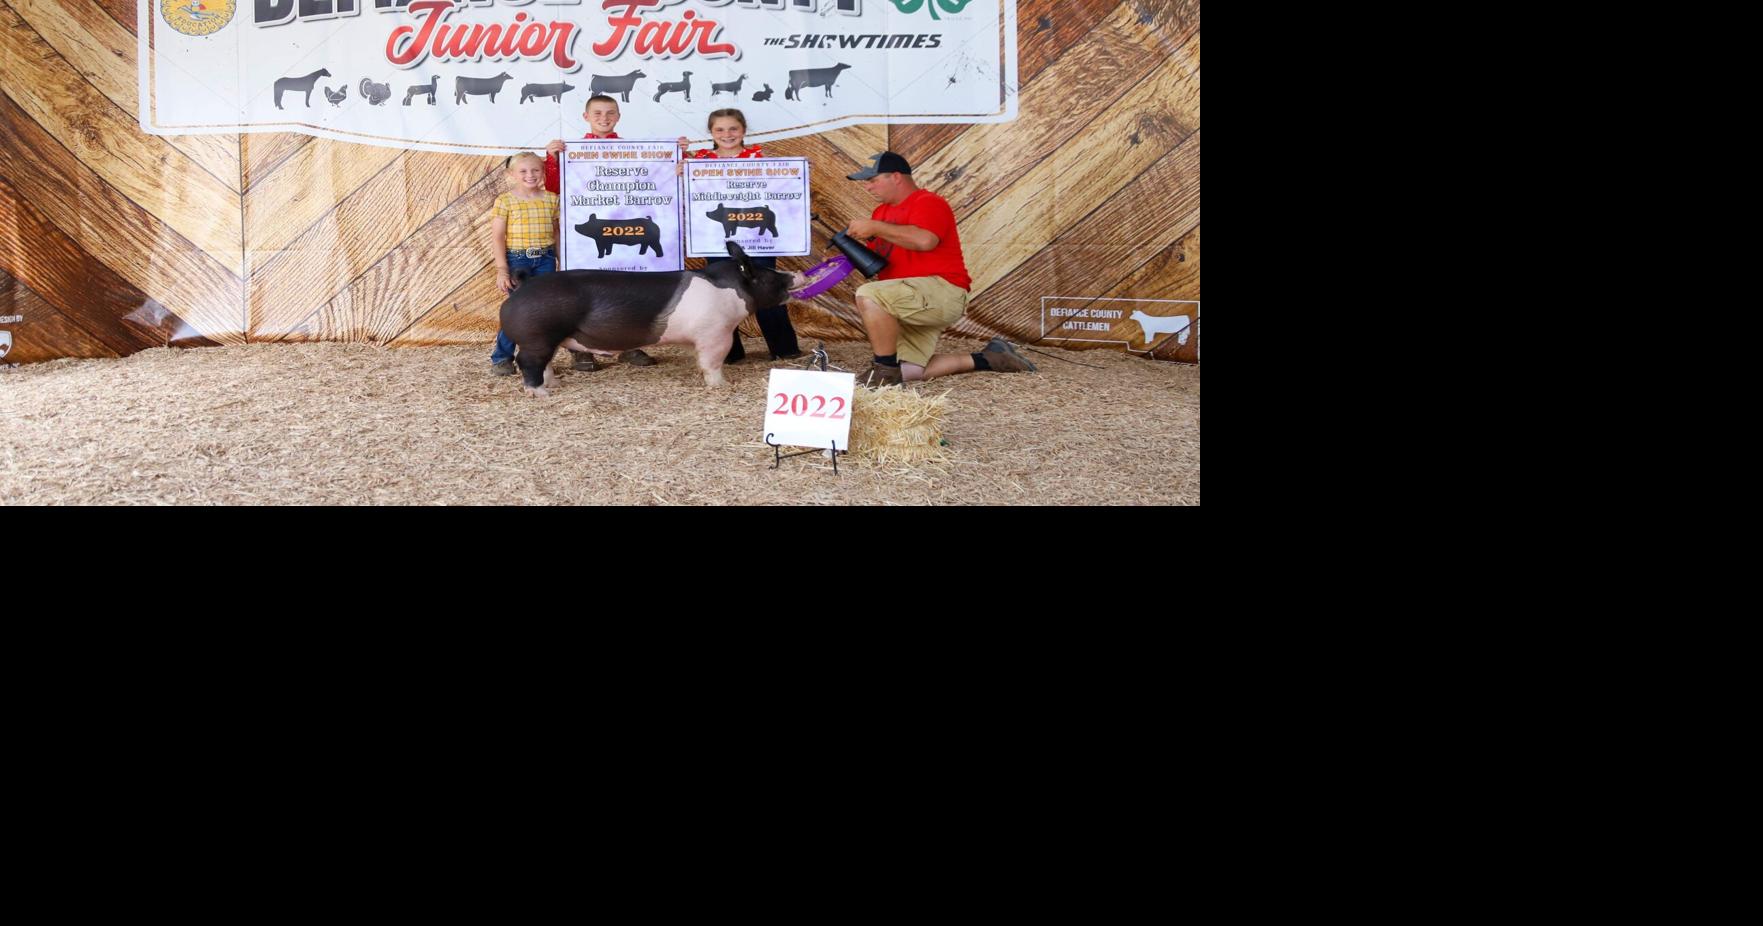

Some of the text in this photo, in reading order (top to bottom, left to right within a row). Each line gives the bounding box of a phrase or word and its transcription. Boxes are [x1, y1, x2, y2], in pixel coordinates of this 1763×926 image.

[387, 1, 576, 69] Junior
[592, 0, 736, 57] Fair
[763, 37, 785, 46] THE
[568, 150, 673, 160] OPEN SWINE SHOW
[595, 165, 649, 176] Reserve
[692, 168, 800, 177] OPEN SWINE SHOW
[587, 180, 657, 193] Champion
[726, 180, 768, 189] Reserve
[570, 195, 673, 207] Market Barrow
[691, 191, 802, 202] Middleweight Barrow
[727, 212, 764, 221] 2022
[602, 226, 645, 236] 2022
[1050, 308, 1123, 319] DEFIANCE COUNTY
[1062, 321, 1110, 331] CATTLEMEN
[772, 392, 846, 420] 2022
